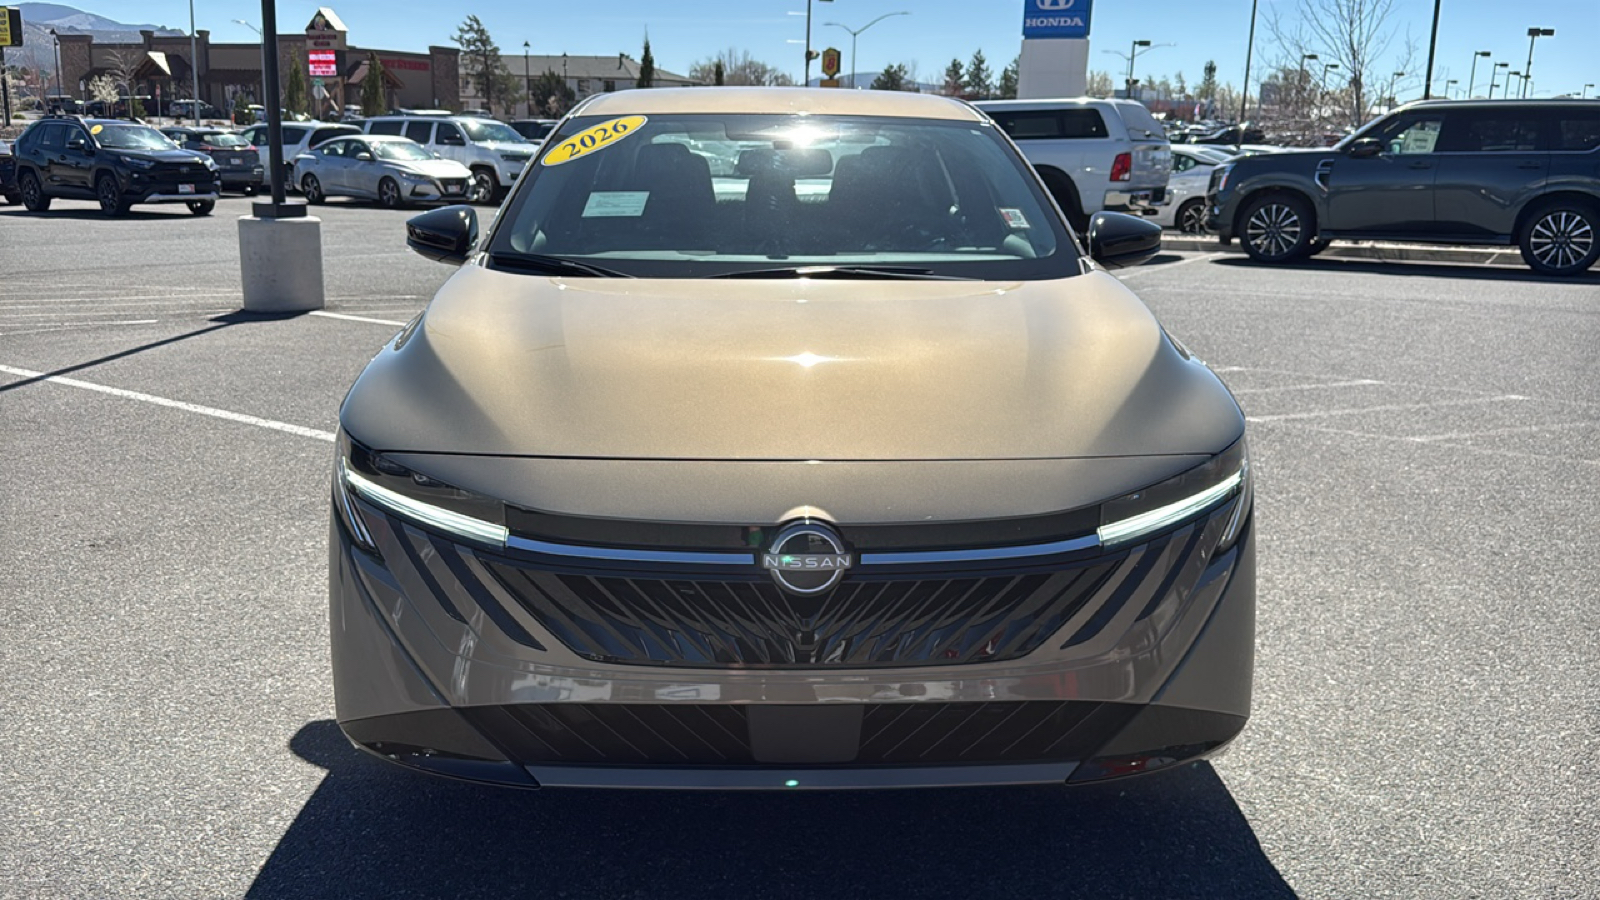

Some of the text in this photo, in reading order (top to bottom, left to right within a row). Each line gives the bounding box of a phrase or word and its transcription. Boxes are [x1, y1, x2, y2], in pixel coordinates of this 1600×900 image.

[1025, 17, 1084, 27] HONDA
[562, 120, 628, 159] 2026
[765, 555, 850, 568] NISSAN
